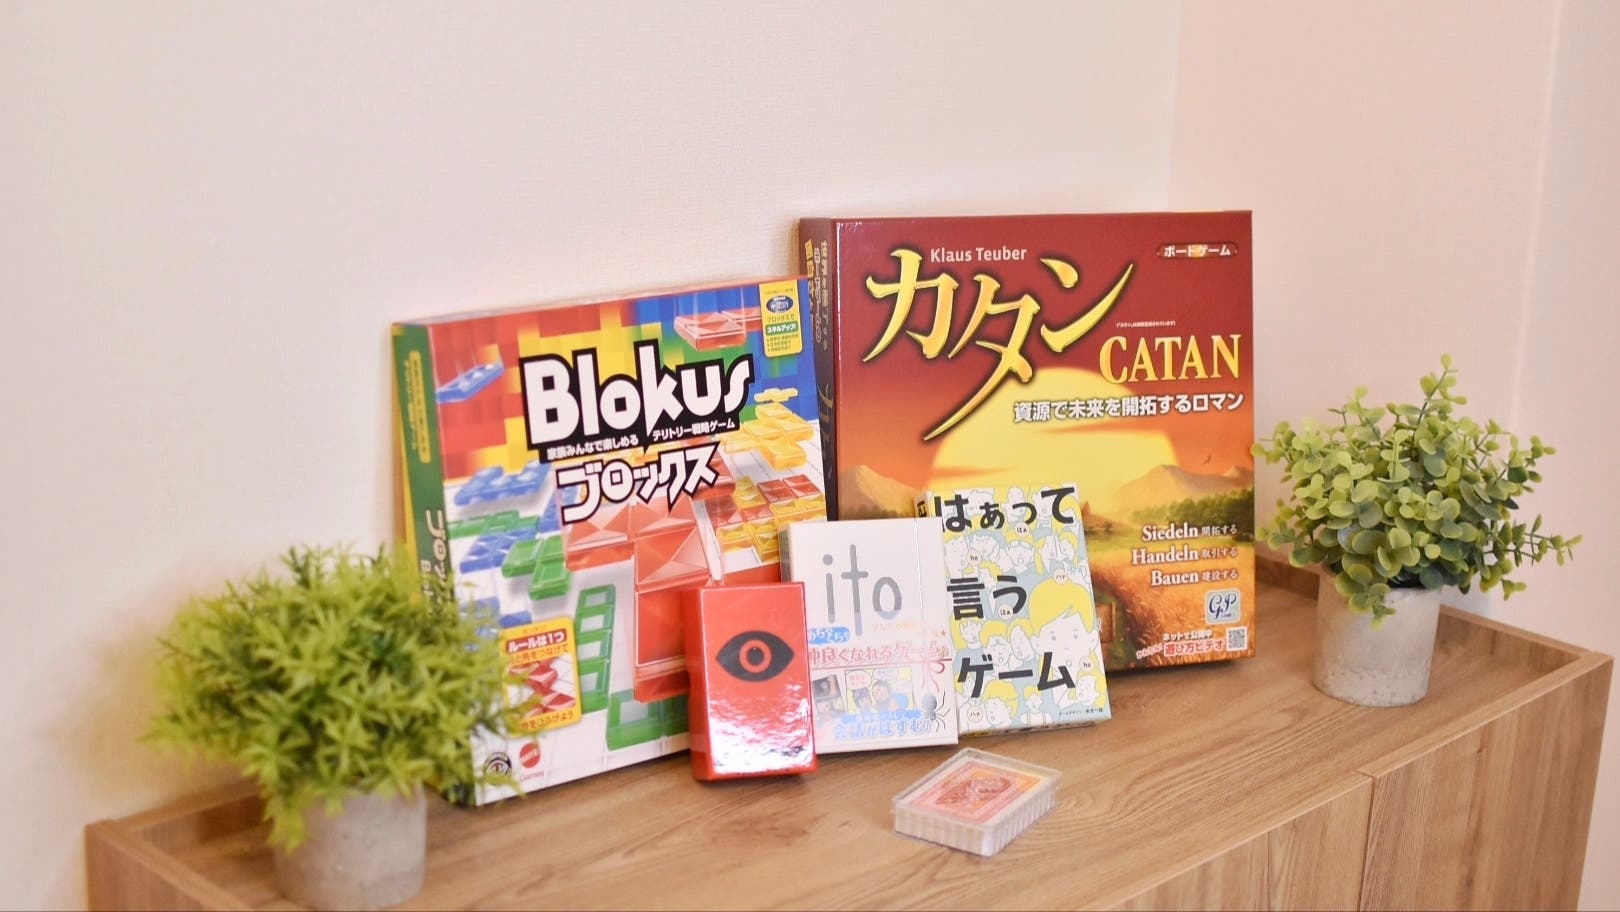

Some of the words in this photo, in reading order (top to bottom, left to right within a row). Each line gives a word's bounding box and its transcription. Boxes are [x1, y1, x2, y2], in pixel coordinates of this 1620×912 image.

[931, 248, 972, 263] Klaus
[976, 246, 1027, 261] Teuber
[1164, 245, 1231, 257] ボードゲーム
[862, 249, 1133, 441] カタン
[1099, 334, 1242, 384] CATAN
[523, 345, 751, 445] Blokus
[1014, 393, 1244, 422] 資源で未来を開拓するロマン
[547, 435, 639, 460] 家族みんなで楽しめる
[652, 419, 735, 442] テリトリー戦略ゲーム
[557, 442, 720, 525] ブロックス
[1142, 522, 1199, 541] Siedeln
[1201, 524, 1237, 536] 開拓する
[1132, 545, 1199, 565] Handeln
[823, 544, 903, 636] ito
[1151, 570, 1199, 586] Bauen
[946, 575, 1027, 620] 言う
[1164, 640, 1224, 655] 遊び方ビデオ
[957, 651, 1075, 698] ゲーム
